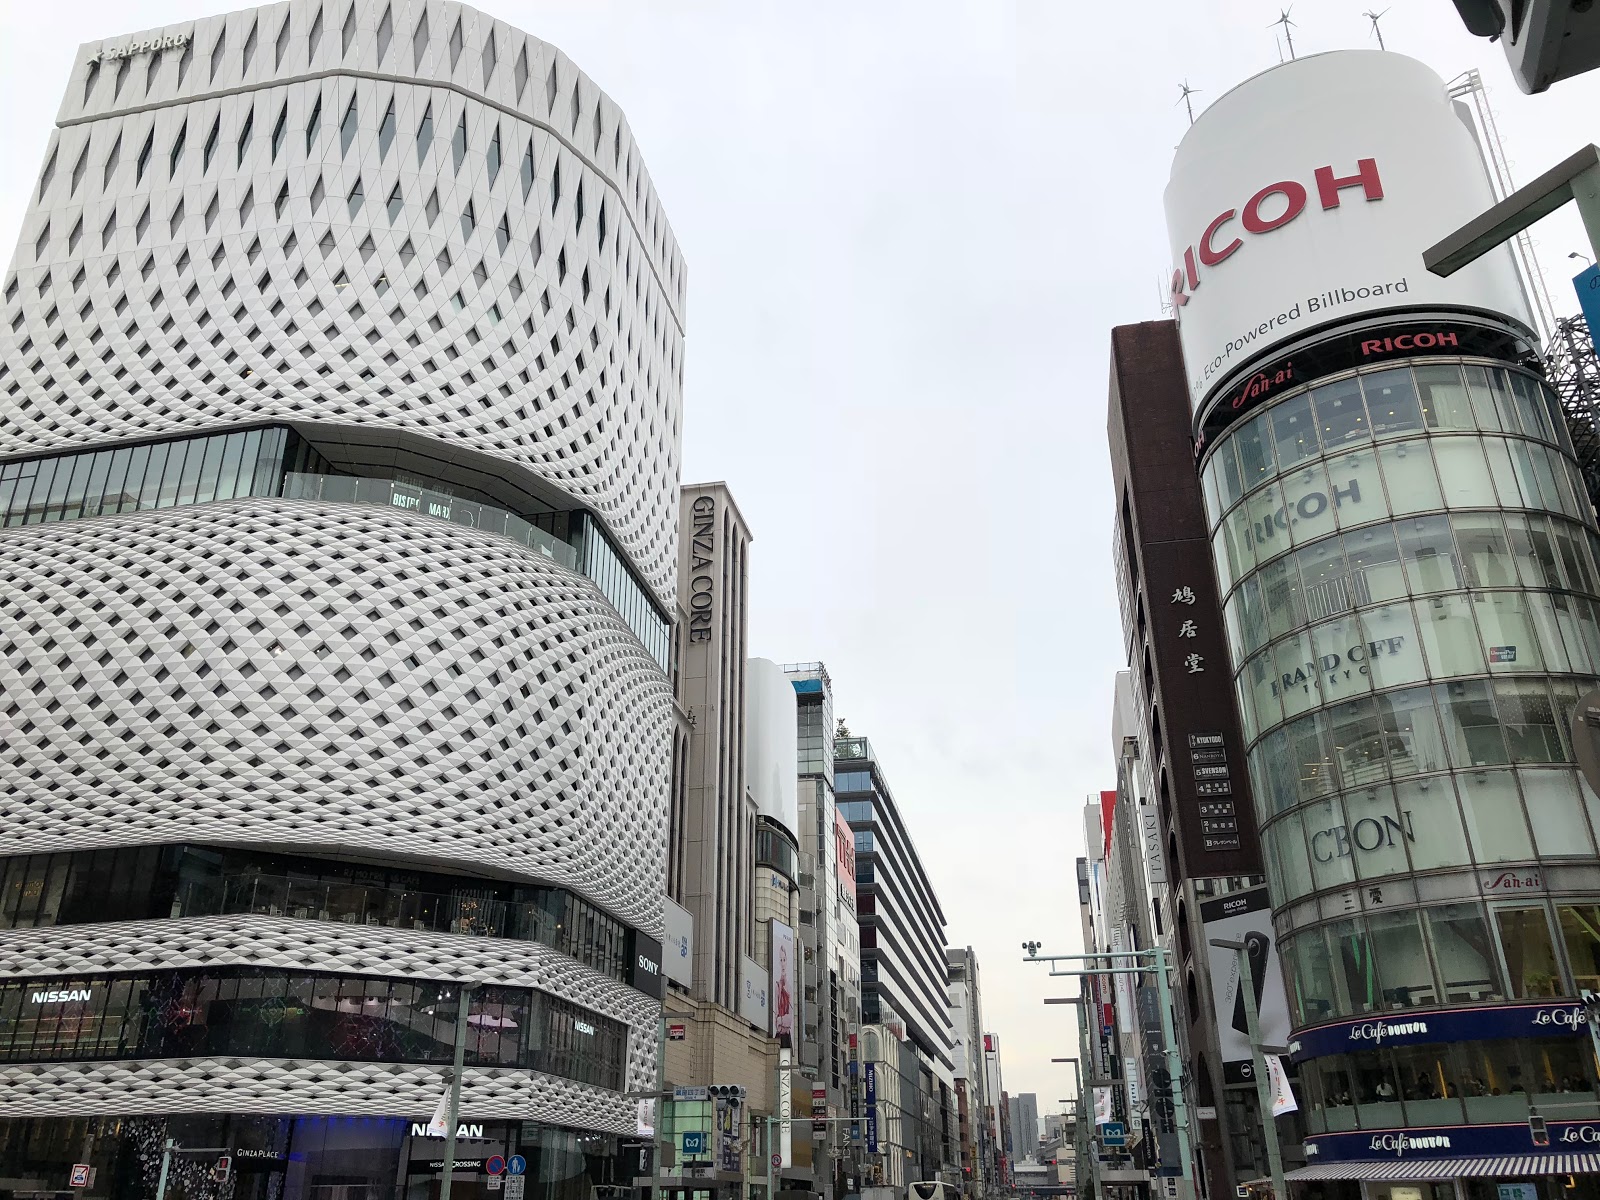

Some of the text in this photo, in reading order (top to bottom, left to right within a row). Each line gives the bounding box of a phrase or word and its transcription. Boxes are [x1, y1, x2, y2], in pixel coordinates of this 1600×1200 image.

[106, 34, 187, 60] SAPPORO
[1170, 157, 1385, 309] RICOH
[1204, 304, 1300, 380] Eco-Powered
[1308, 277, 1410, 313] Billboard
[1361, 332, 1459, 356] RICOH
[1243, 479, 1362, 552] RICOH
[690, 496, 715, 643] GINZA CORE
[1170, 585, 1205, 674] 鳩居堂
[1201, 767, 1227, 775] SVENSON
[1144, 814, 1162, 875] TASAKI
[1223, 898, 1247, 910] RICOH
[1341, 887, 1384, 911] 三愛
[638, 953, 660, 976] SONY
[32, 989, 91, 1004] NISSAN
[574, 1020, 594, 1036] NISSAN
[1531, 1007, 1586, 1032] Le Café
[1348, 1021, 1428, 1045] Le Café DOUTOR
[236, 1148, 279, 1159] GINZA PLACE
[842, 1128, 851, 1162] FANCL
[1368, 1132, 1451, 1157] Le Café DOUTOR
[452, 1160, 482, 1168] CROSSING
